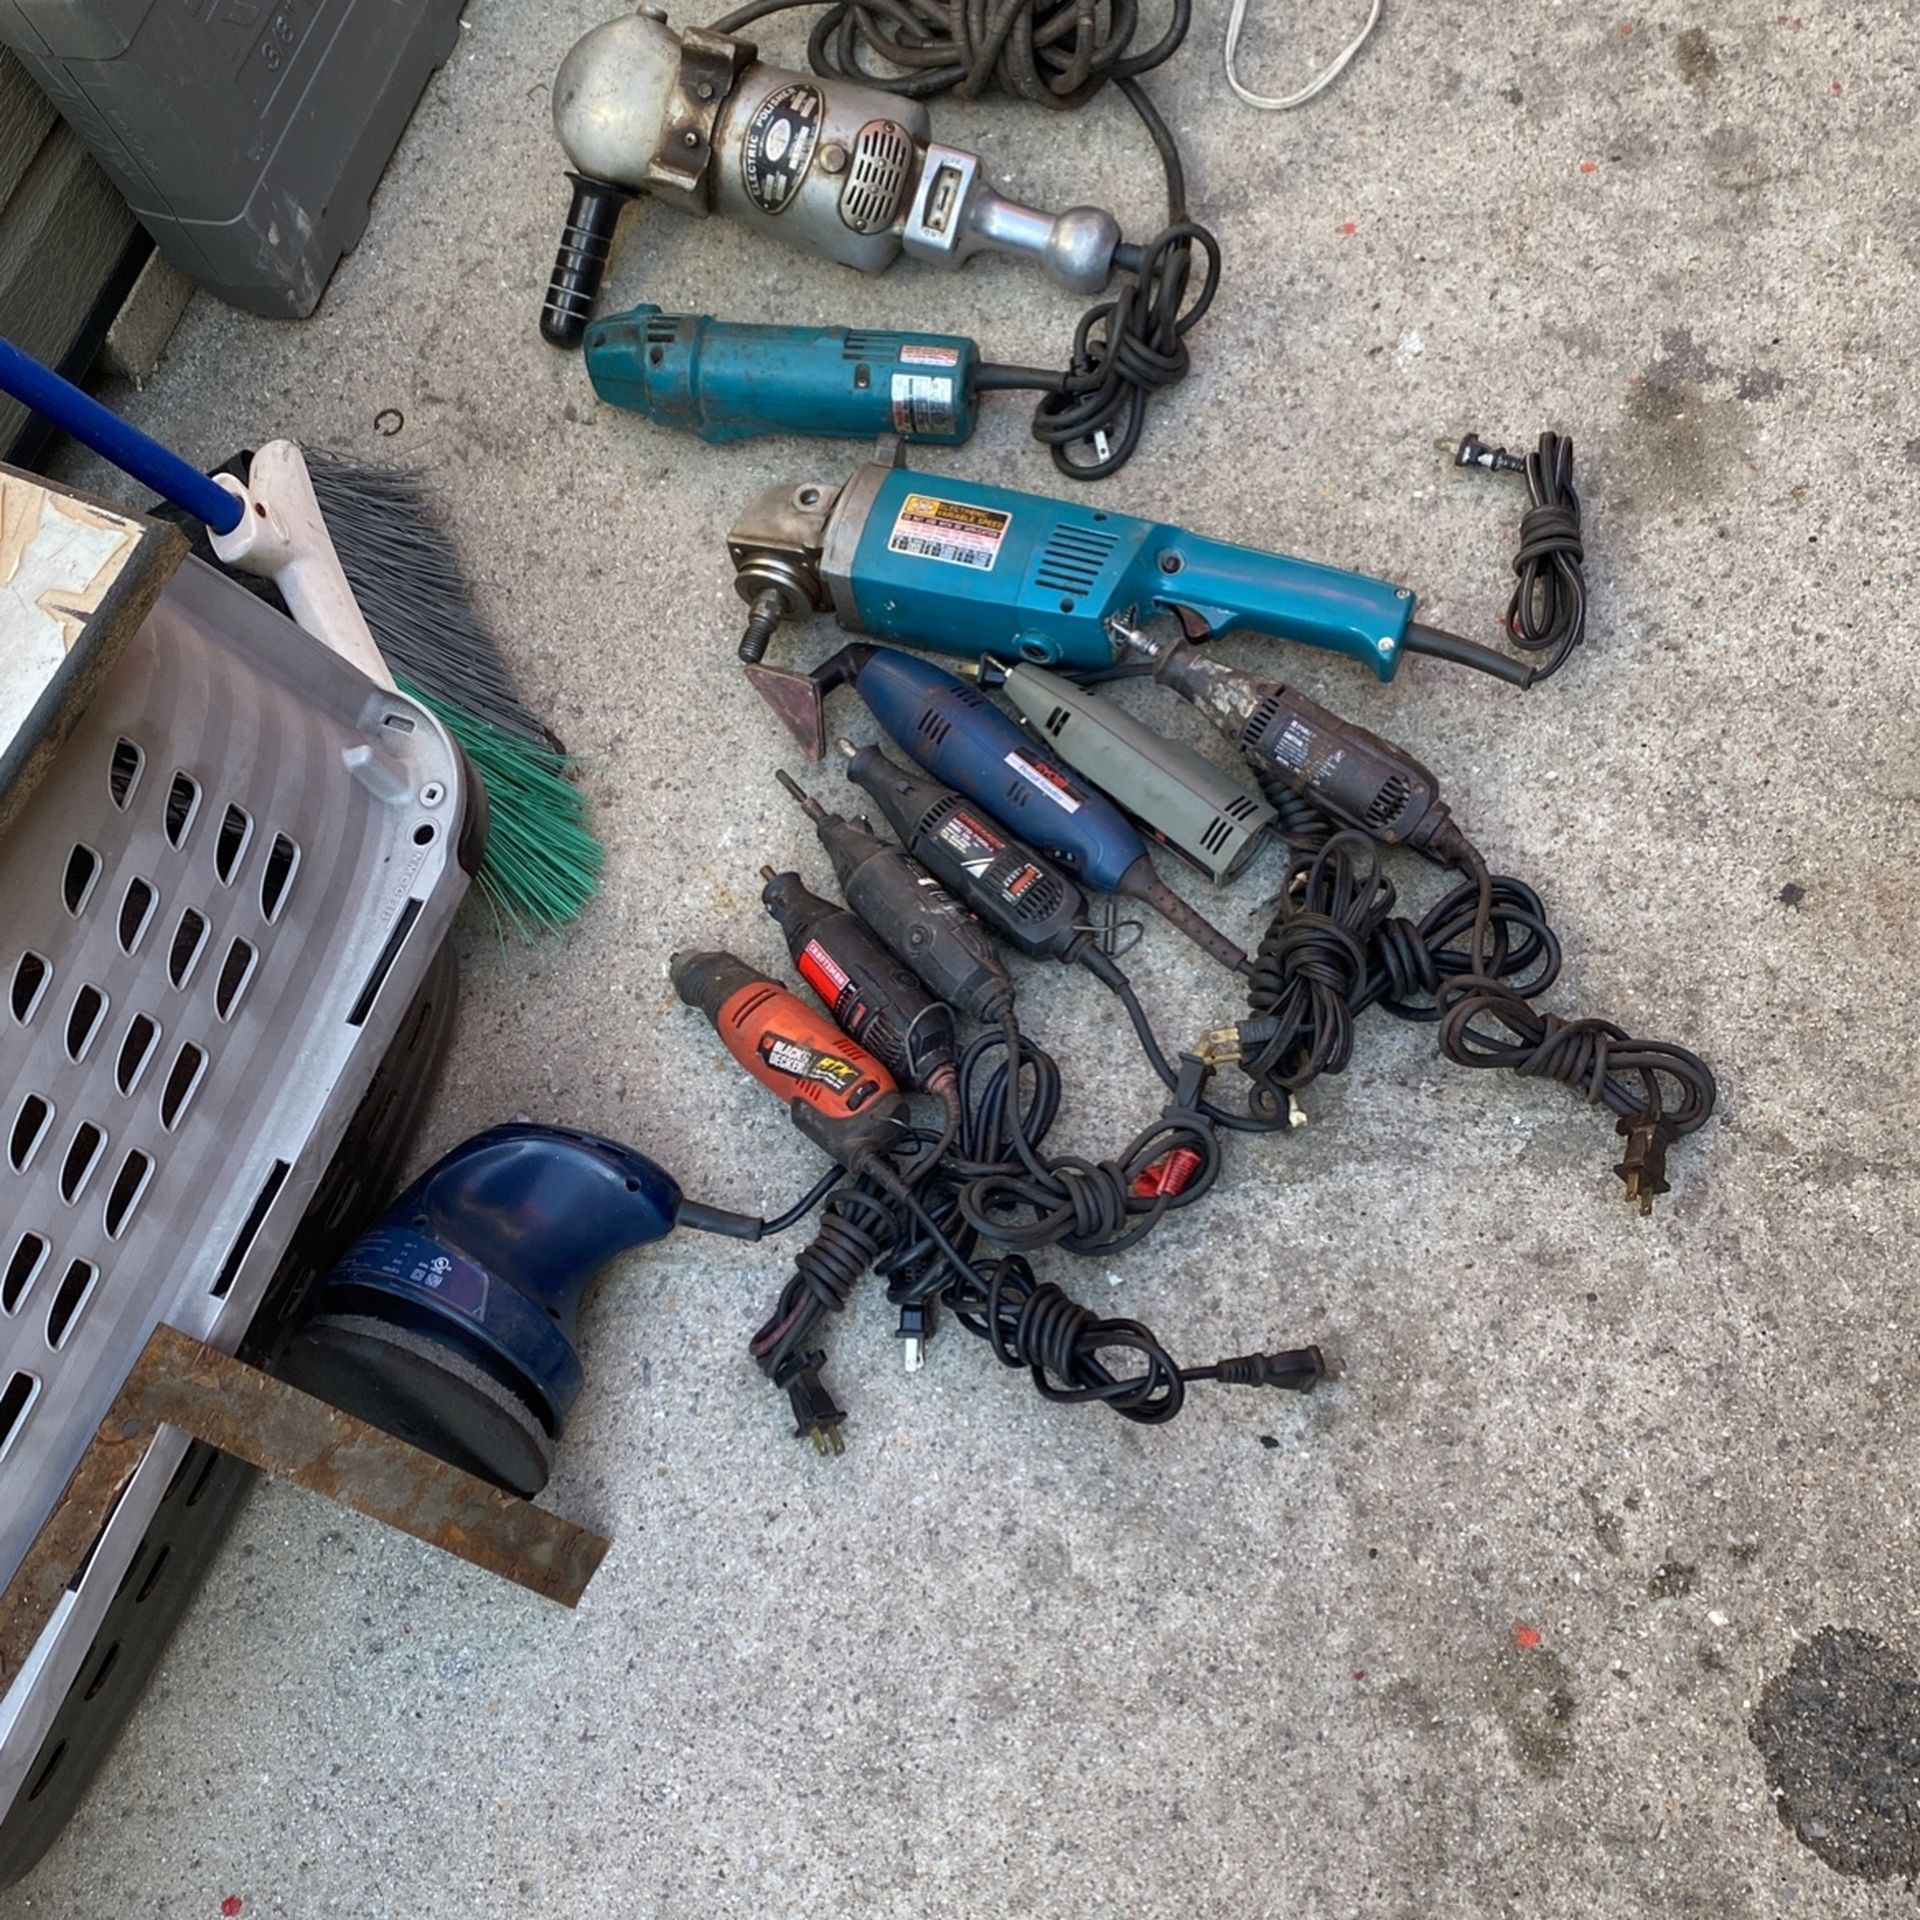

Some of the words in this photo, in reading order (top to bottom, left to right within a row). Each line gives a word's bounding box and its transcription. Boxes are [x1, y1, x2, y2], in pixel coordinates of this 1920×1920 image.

[746, 133, 761, 196] ELECTRIC
[755, 86, 797, 128] POLISHER
[808, 942, 846, 986] CRAFTSMAN
[769, 1052, 806, 1074] DECKER
